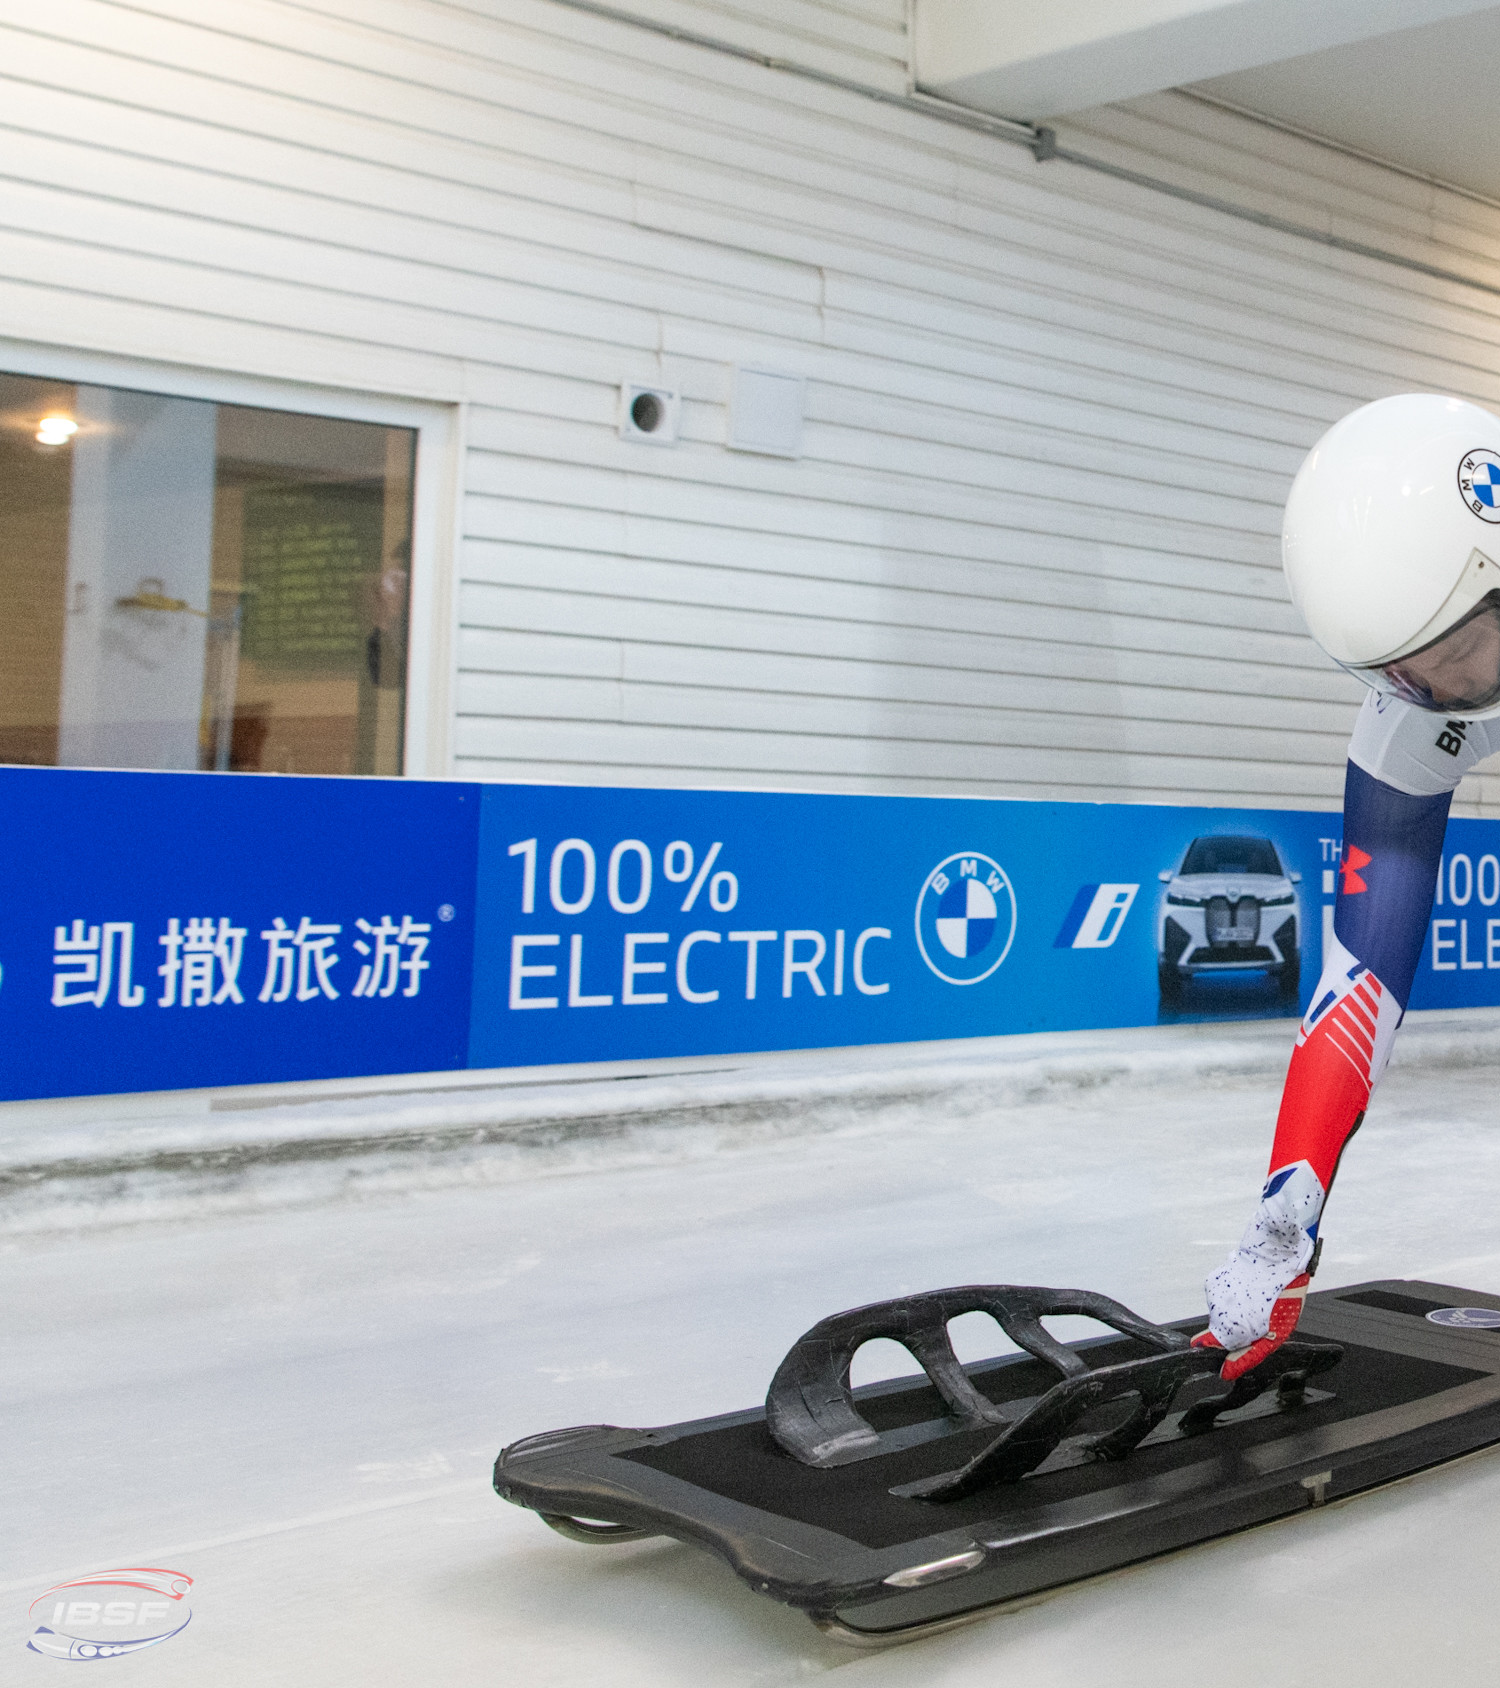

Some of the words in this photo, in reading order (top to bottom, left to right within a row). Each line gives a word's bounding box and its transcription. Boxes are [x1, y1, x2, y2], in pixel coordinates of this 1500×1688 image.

[1435, 720, 1474, 757] BM
[508, 837, 740, 915] 100%
[51, 915, 432, 1009] 凯撒旅游
[508, 926, 893, 1011] ELECTRIC
